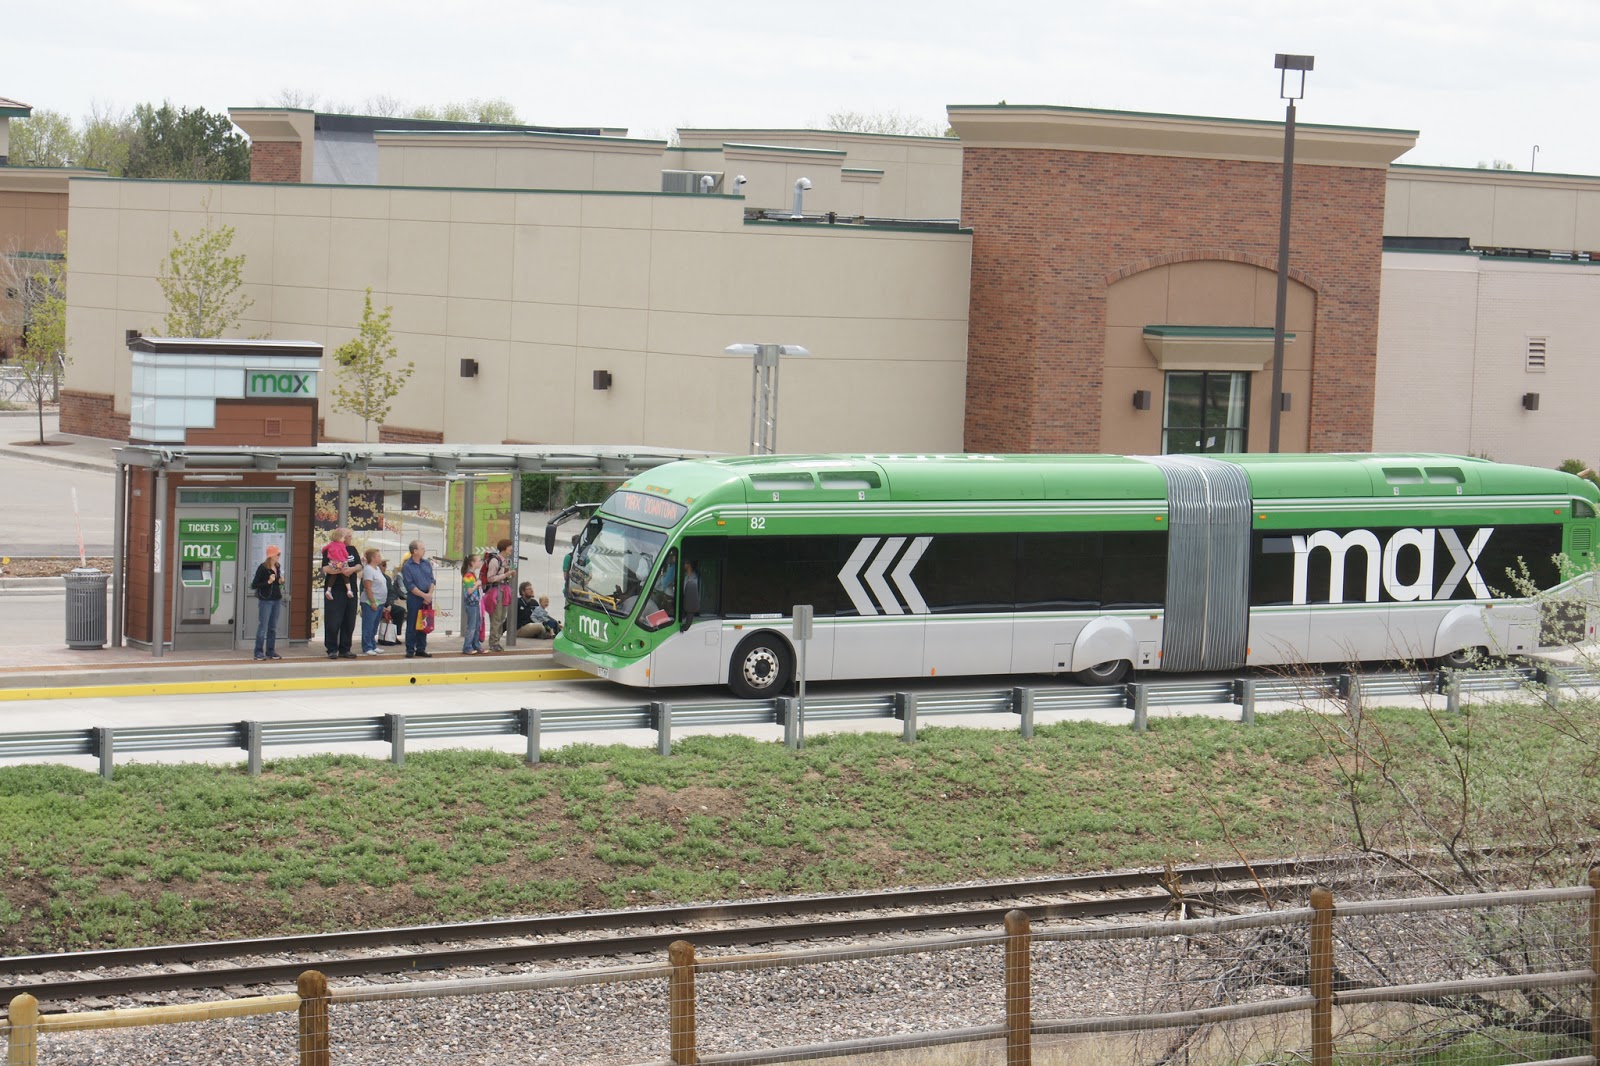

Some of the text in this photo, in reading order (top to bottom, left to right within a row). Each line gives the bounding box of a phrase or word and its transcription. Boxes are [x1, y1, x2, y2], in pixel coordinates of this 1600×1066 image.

[251, 373, 310, 394] max
[624, 493, 641, 511] MAX
[188, 523, 220, 532] TICKETS
[252, 521, 276, 531] max
[750, 517, 766, 529] 82
[184, 544, 221, 557] max
[1291, 527, 1495, 605] max
[579, 615, 609, 640] max
